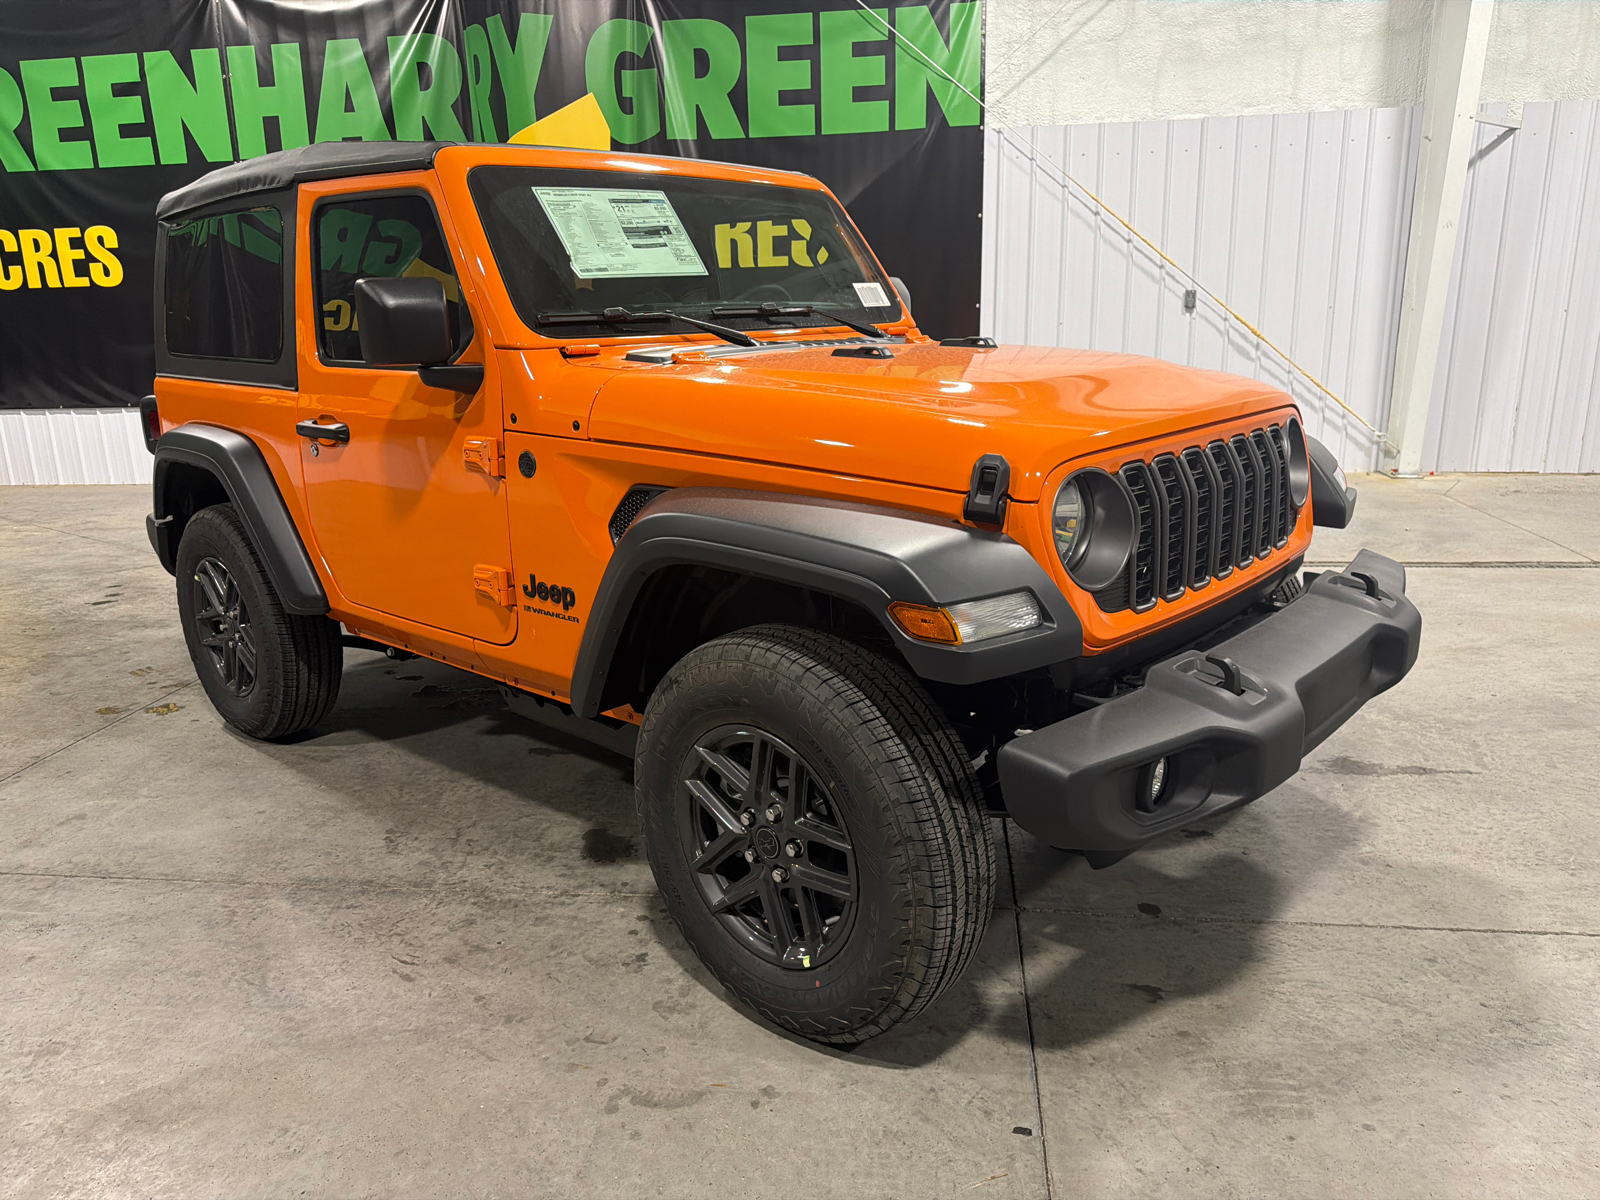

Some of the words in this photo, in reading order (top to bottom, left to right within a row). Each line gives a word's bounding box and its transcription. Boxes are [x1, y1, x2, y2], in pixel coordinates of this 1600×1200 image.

[226, 12, 554, 160] HARRY
[584, 2, 982, 145] GREEN
[522, 573, 577, 612] Jeep
[531, 606, 580, 624] WRANGLER
